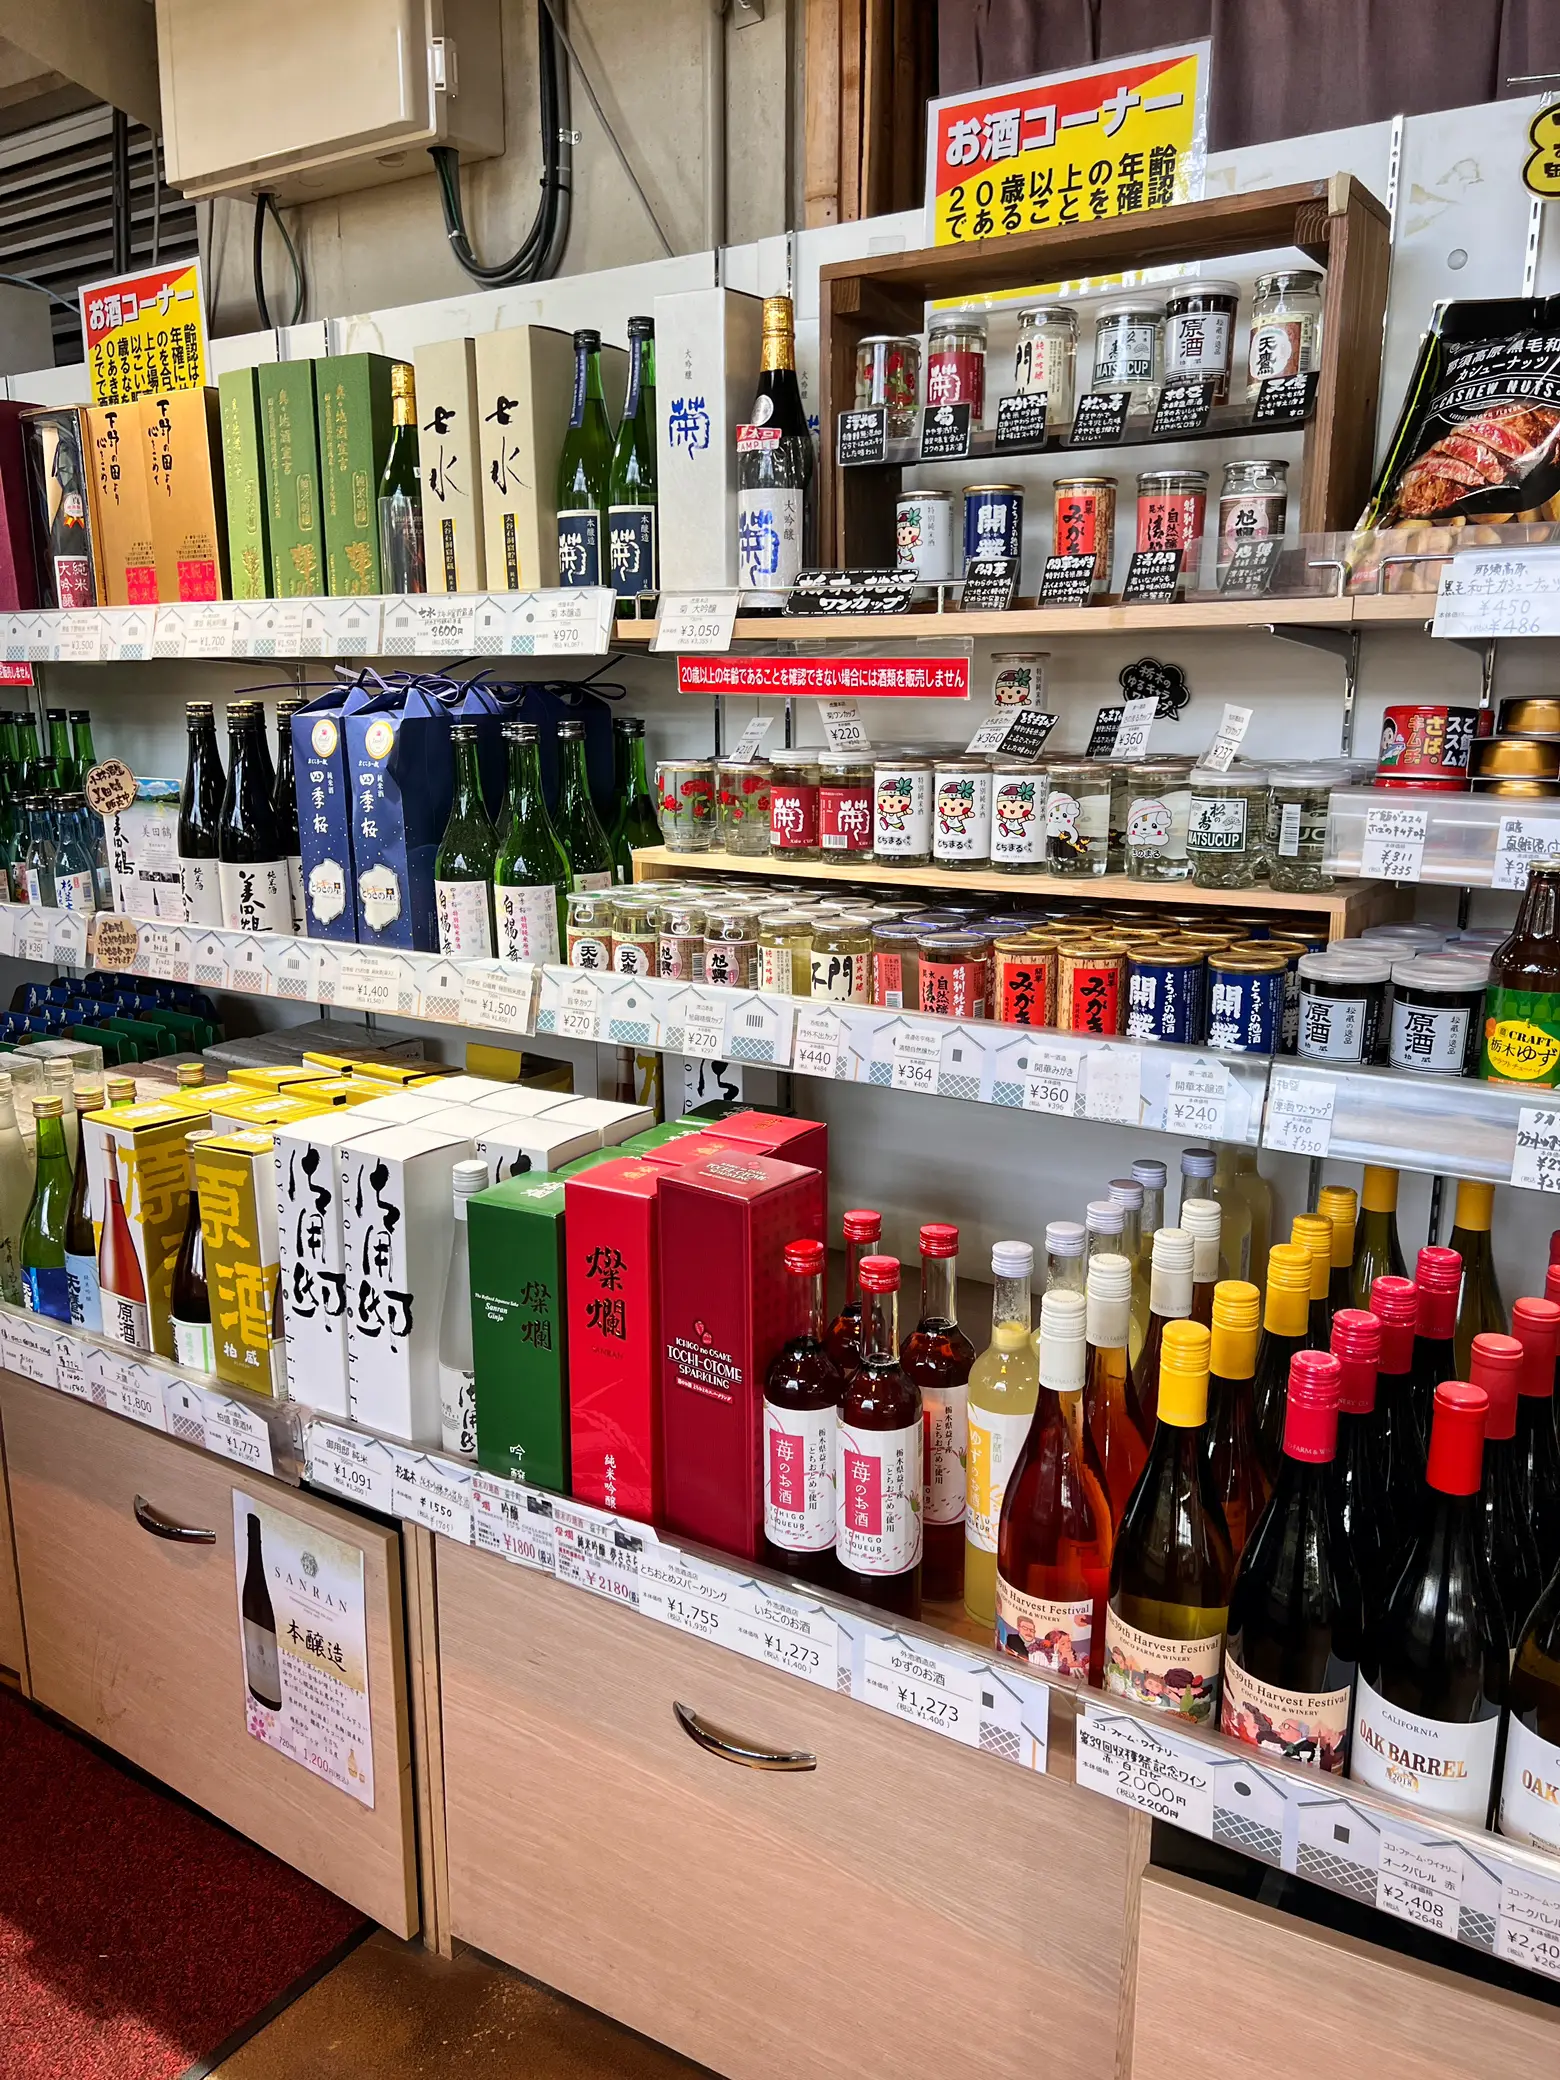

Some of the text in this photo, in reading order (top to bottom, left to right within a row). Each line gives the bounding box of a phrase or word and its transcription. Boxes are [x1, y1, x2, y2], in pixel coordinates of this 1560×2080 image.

[945, 86, 1184, 167] お酒コーナー
[946, 176, 1175, 237] であることを確認
[89, 283, 194, 330] お酒コーナー
[1179, 317, 1205, 358] 原酒
[95, 344, 199, 377] であることを確認
[685, 348, 693, 380] 大吟醸
[1256, 336, 1277, 376] 天鷹
[1455, 355, 1550, 383] カシューナッツ
[1439, 379, 1554, 409] CASHEW NUTS
[641, 513, 650, 542] 本醸造
[783, 499, 795, 540] 大吟醸
[692, 603, 717, 613] 大吟醸
[820, 595, 905, 611] ワンカップ
[1479, 600, 1531, 615] ¥450
[553, 629, 579, 641] ¥970
[680, 624, 719, 638] ¥3,050
[1488, 617, 1540, 634] ¥486
[200, 637, 226, 647] ¥1,700
[682, 666, 965, 688] 20歳以上の年齢であることを確認できない場合には酒類を販売しません
[831, 727, 860, 741] ¥220
[976, 732, 1003, 743] ¥360
[1119, 732, 1144, 745] ¥360
[1403, 715, 1424, 765] キムチ
[1423, 715, 1445, 764] さばの
[1442, 716, 1462, 767] ススム
[1213, 744, 1233, 760] ¥237
[310, 770, 329, 834] 四季桜
[359, 773, 378, 839] 四季桜
[1381, 849, 1413, 863] ¥311
[1383, 862, 1412, 877] ¥335
[357, 983, 389, 998] ¥1,400
[952, 966, 966, 1017] 特別純米
[1162, 971, 1176, 1034] とちぎの地酒
[482, 998, 517, 1017] ¥1,500
[1250, 980, 1263, 1044] とちぎの地酒
[563, 1015, 590, 1029] ¥270
[1305, 1001, 1334, 1044] 原酒
[1344, 1006, 1356, 1045] 秘蔵の逸品
[1405, 1010, 1439, 1055] 原酒
[688, 1033, 717, 1047] ¥270
[1447, 1016, 1461, 1055] 秘蔵の逸品
[1509, 1030, 1553, 1047] CRAFT
[799, 1050, 831, 1065] ¥440
[1490, 1038, 1558, 1067] 栃木ゆず
[898, 1064, 933, 1082] ¥364
[1033, 1063, 1074, 1078] 開華みがき
[914, 1081, 929, 1089] ¥400
[1030, 1084, 1069, 1103] ¥360
[1175, 1081, 1225, 1094] 開華本醸造
[1048, 1103, 1065, 1111] ¥396
[1174, 1103, 1218, 1122] ¥240
[1283, 1122, 1312, 1135] ¥500
[1292, 1137, 1322, 1152] ¥550
[195, 1164, 272, 1350] 原酒
[485, 1302, 508, 1314] Sanran
[487, 1312, 504, 1322] Ginjo
[117, 1300, 137, 1345] 原酒
[675, 1337, 699, 1352] ICHIGO
[709, 1347, 732, 1363] OSAKE
[667, 1345, 742, 1381] TOCHI-OTOME
[679, 1364, 729, 1389] SPARKLING
[121, 1391, 152, 1413] ¥1,800
[226, 1434, 261, 1458] ¥1,773
[326, 1438, 369, 1465] 御用邸 純米
[334, 1462, 372, 1491] ¥1,091
[604, 1454, 617, 1510] 純米吟醸
[776, 1439, 794, 1504] 苺のお酒
[851, 1460, 871, 1528] 苺のお酒
[419, 1497, 452, 1518] ¥1550
[770, 1506, 805, 1520] ICHIGO
[770, 1515, 805, 1529] LIQUEUR
[577, 1535, 606, 1557] 純米吟醸
[845, 1530, 882, 1543] ICHIGO
[845, 1538, 882, 1553] LIQUEUR
[502, 1532, 536, 1559] ¥1800
[538, 1549, 556, 1567] (税込)
[274, 1566, 348, 1613] SANRAN
[598, 1575, 629, 1597] 2180
[640, 1561, 728, 1602] とちおとめスパークリング
[667, 1597, 719, 1628] ¥1,755
[765, 1600, 799, 1617] 外池酒造店
[1009, 1590, 1090, 1615] Harvest Festival
[1013, 1603, 1061, 1623] FARM WINERY
[754, 1605, 811, 1634] いちごのお酒
[286, 1619, 347, 1672] 本醸造
[764, 1633, 819, 1666] ¥1,273
[1133, 1632, 1219, 1654] Harvest Festival
[1136, 1645, 1156, 1658] FARM
[1164, 1653, 1191, 1663] WINERY
[782, 1657, 807, 1672] ¥1,400
[891, 1655, 945, 1687] ゆずのお酒
[900, 1650, 936, 1669] 外池酒造店
[866, 1678, 959, 1722] 本体価格 ¥1,273
[1235, 1670, 1347, 1707] 39th Harvest Festival
[1240, 1687, 1319, 1716] COCO FARM WINERY
[917, 1709, 944, 1727] ¥1,400
[1381, 1710, 1439, 1739] CALIFORNIA
[1093, 1721, 1179, 1758] ココ・ファーム・ワイナリー
[1360, 1718, 1468, 1778] OAK BARREL
[1079, 1729, 1207, 1788] 第39回収穫祭記念ワイン
[1391, 1774, 1412, 1787] 2018
[1522, 1768, 1559, 1806] OAK
[1138, 1795, 1179, 1819] 2200円
[1383, 1842, 1458, 1874] ココ・ファーム・ワイナリー
[1383, 1857, 1456, 1892] オークバレル 赤
[1402, 1880, 1433, 1897] 本体価格
[1383, 1886, 1444, 1918] ¥2,408
[1407, 1908, 1443, 1929] ¥2648
